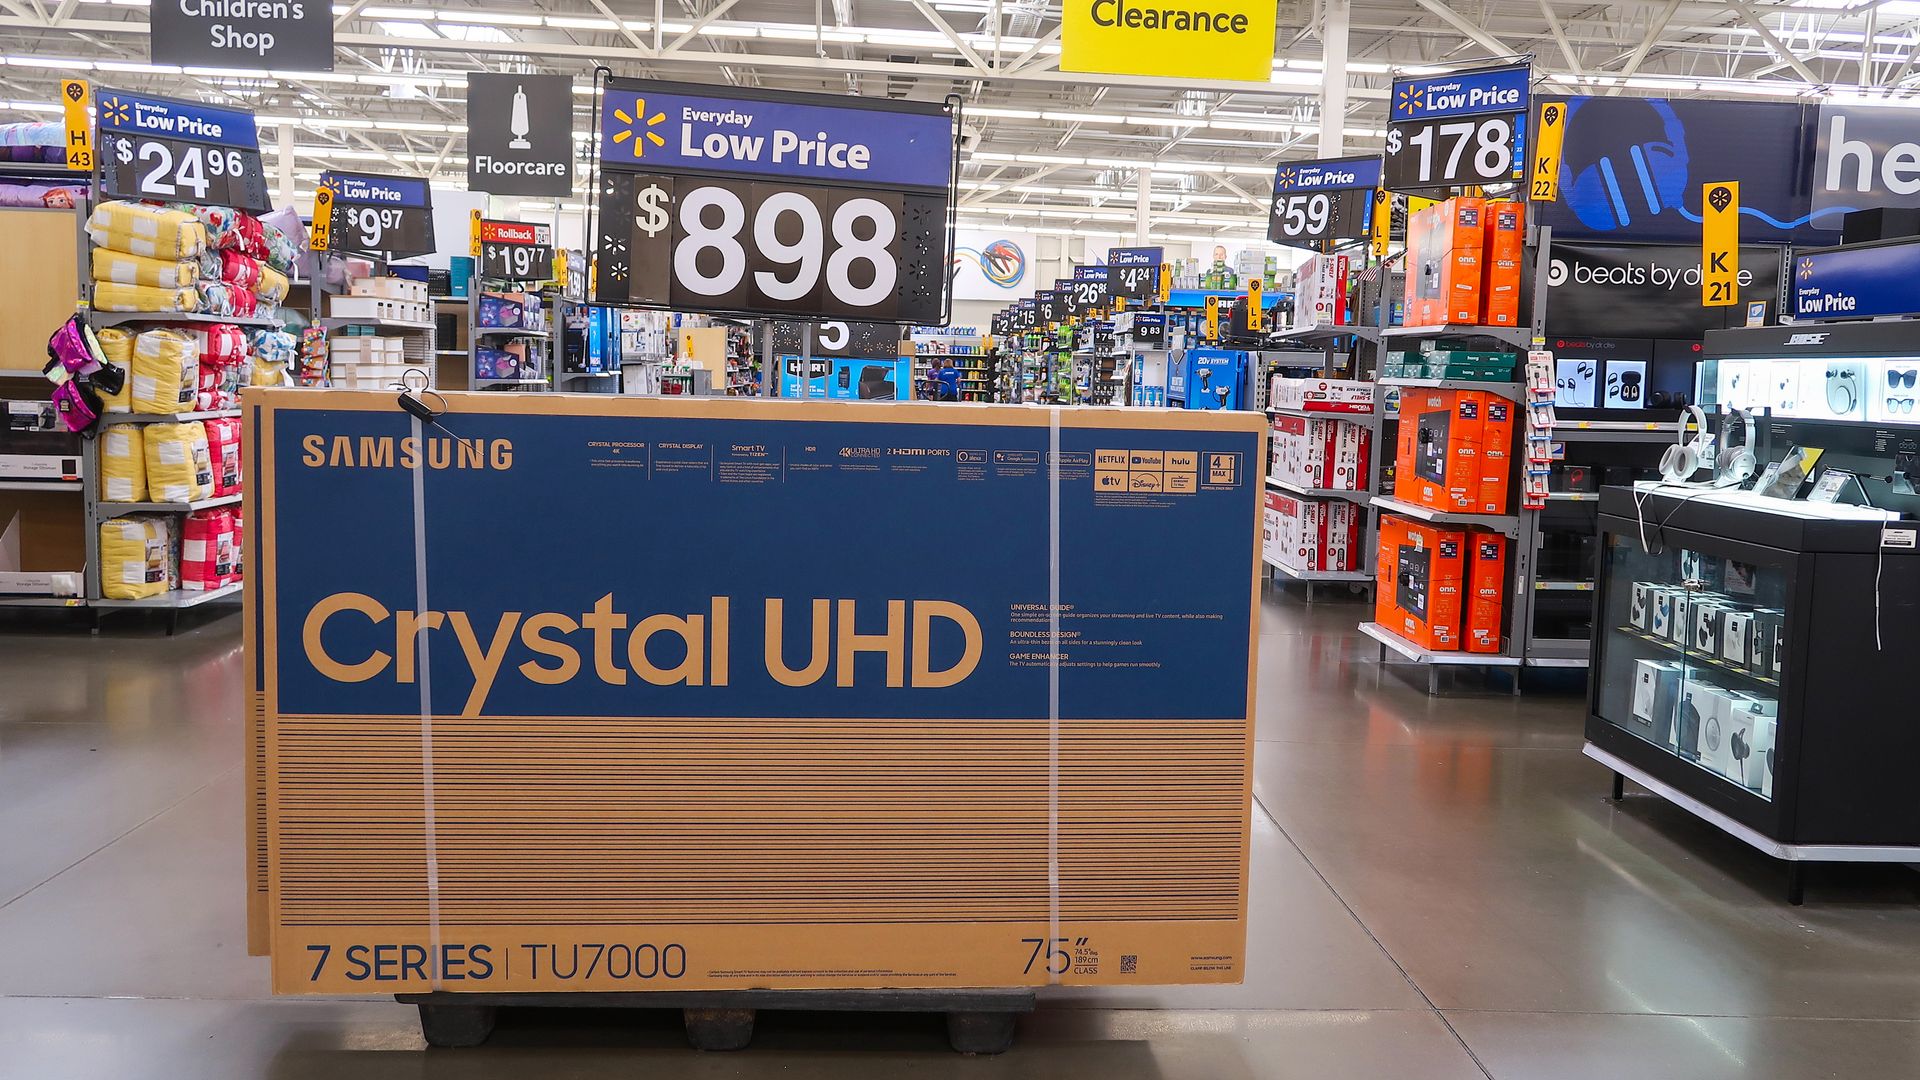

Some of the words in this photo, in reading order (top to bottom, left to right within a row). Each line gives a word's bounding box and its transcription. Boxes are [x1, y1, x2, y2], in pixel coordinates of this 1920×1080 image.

[180, 0, 304, 20] Children's
[1091, 0, 1249, 33] Clearance
[211, 24, 275, 55] Shop
[1427, 83, 1462, 94] Everyday
[1427, 92, 1466, 112] Low
[1470, 86, 1519, 106] Price
[134, 103, 168, 115] Everyday
[136, 110, 174, 131] Low
[178, 116, 222, 137] Price
[682, 107, 753, 128] Everyday
[71, 131, 86, 145] H
[680, 123, 764, 161] Low
[772, 131, 871, 170] Price
[70, 152, 91, 166] 43
[475, 155, 566, 176] Floorcare
[1538, 157, 1551, 174] K
[1298, 174, 1323, 187] Low
[1324, 171, 1354, 185] Price
[344, 185, 370, 199] Low
[371, 187, 401, 201] Price
[1533, 181, 1550, 196] 22
[315, 224, 326, 234] H
[498, 228, 532, 240] Rollback
[1376, 226, 1382, 238] L
[312, 239, 326, 248] 45
[1376, 243, 1382, 253] 2
[1710, 252, 1729, 273] K
[1574, 262, 1645, 286] beats
[1651, 262, 1682, 290] by
[1709, 282, 1731, 302] 21
[1799, 296, 1823, 313] Low
[1825, 293, 1856, 312] Price
[1252, 308, 1257, 317] L
[1251, 320, 1257, 328] 4
[1210, 330, 1215, 338] 5
[302, 434, 513, 470] SAMSUNG
[1098, 455, 1126, 464] NETFLIX
[1171, 457, 1190, 465] hulu
[1212, 456, 1221, 468] 4
[1110, 477, 1121, 486] tv
[302, 591, 730, 718] Crystal
[765, 598, 983, 689] UHD
[307, 945, 331, 981] 7
[345, 944, 494, 981] SERIES
[521, 943, 687, 980] TU7000
[1074, 967, 1098, 975] CLASS
